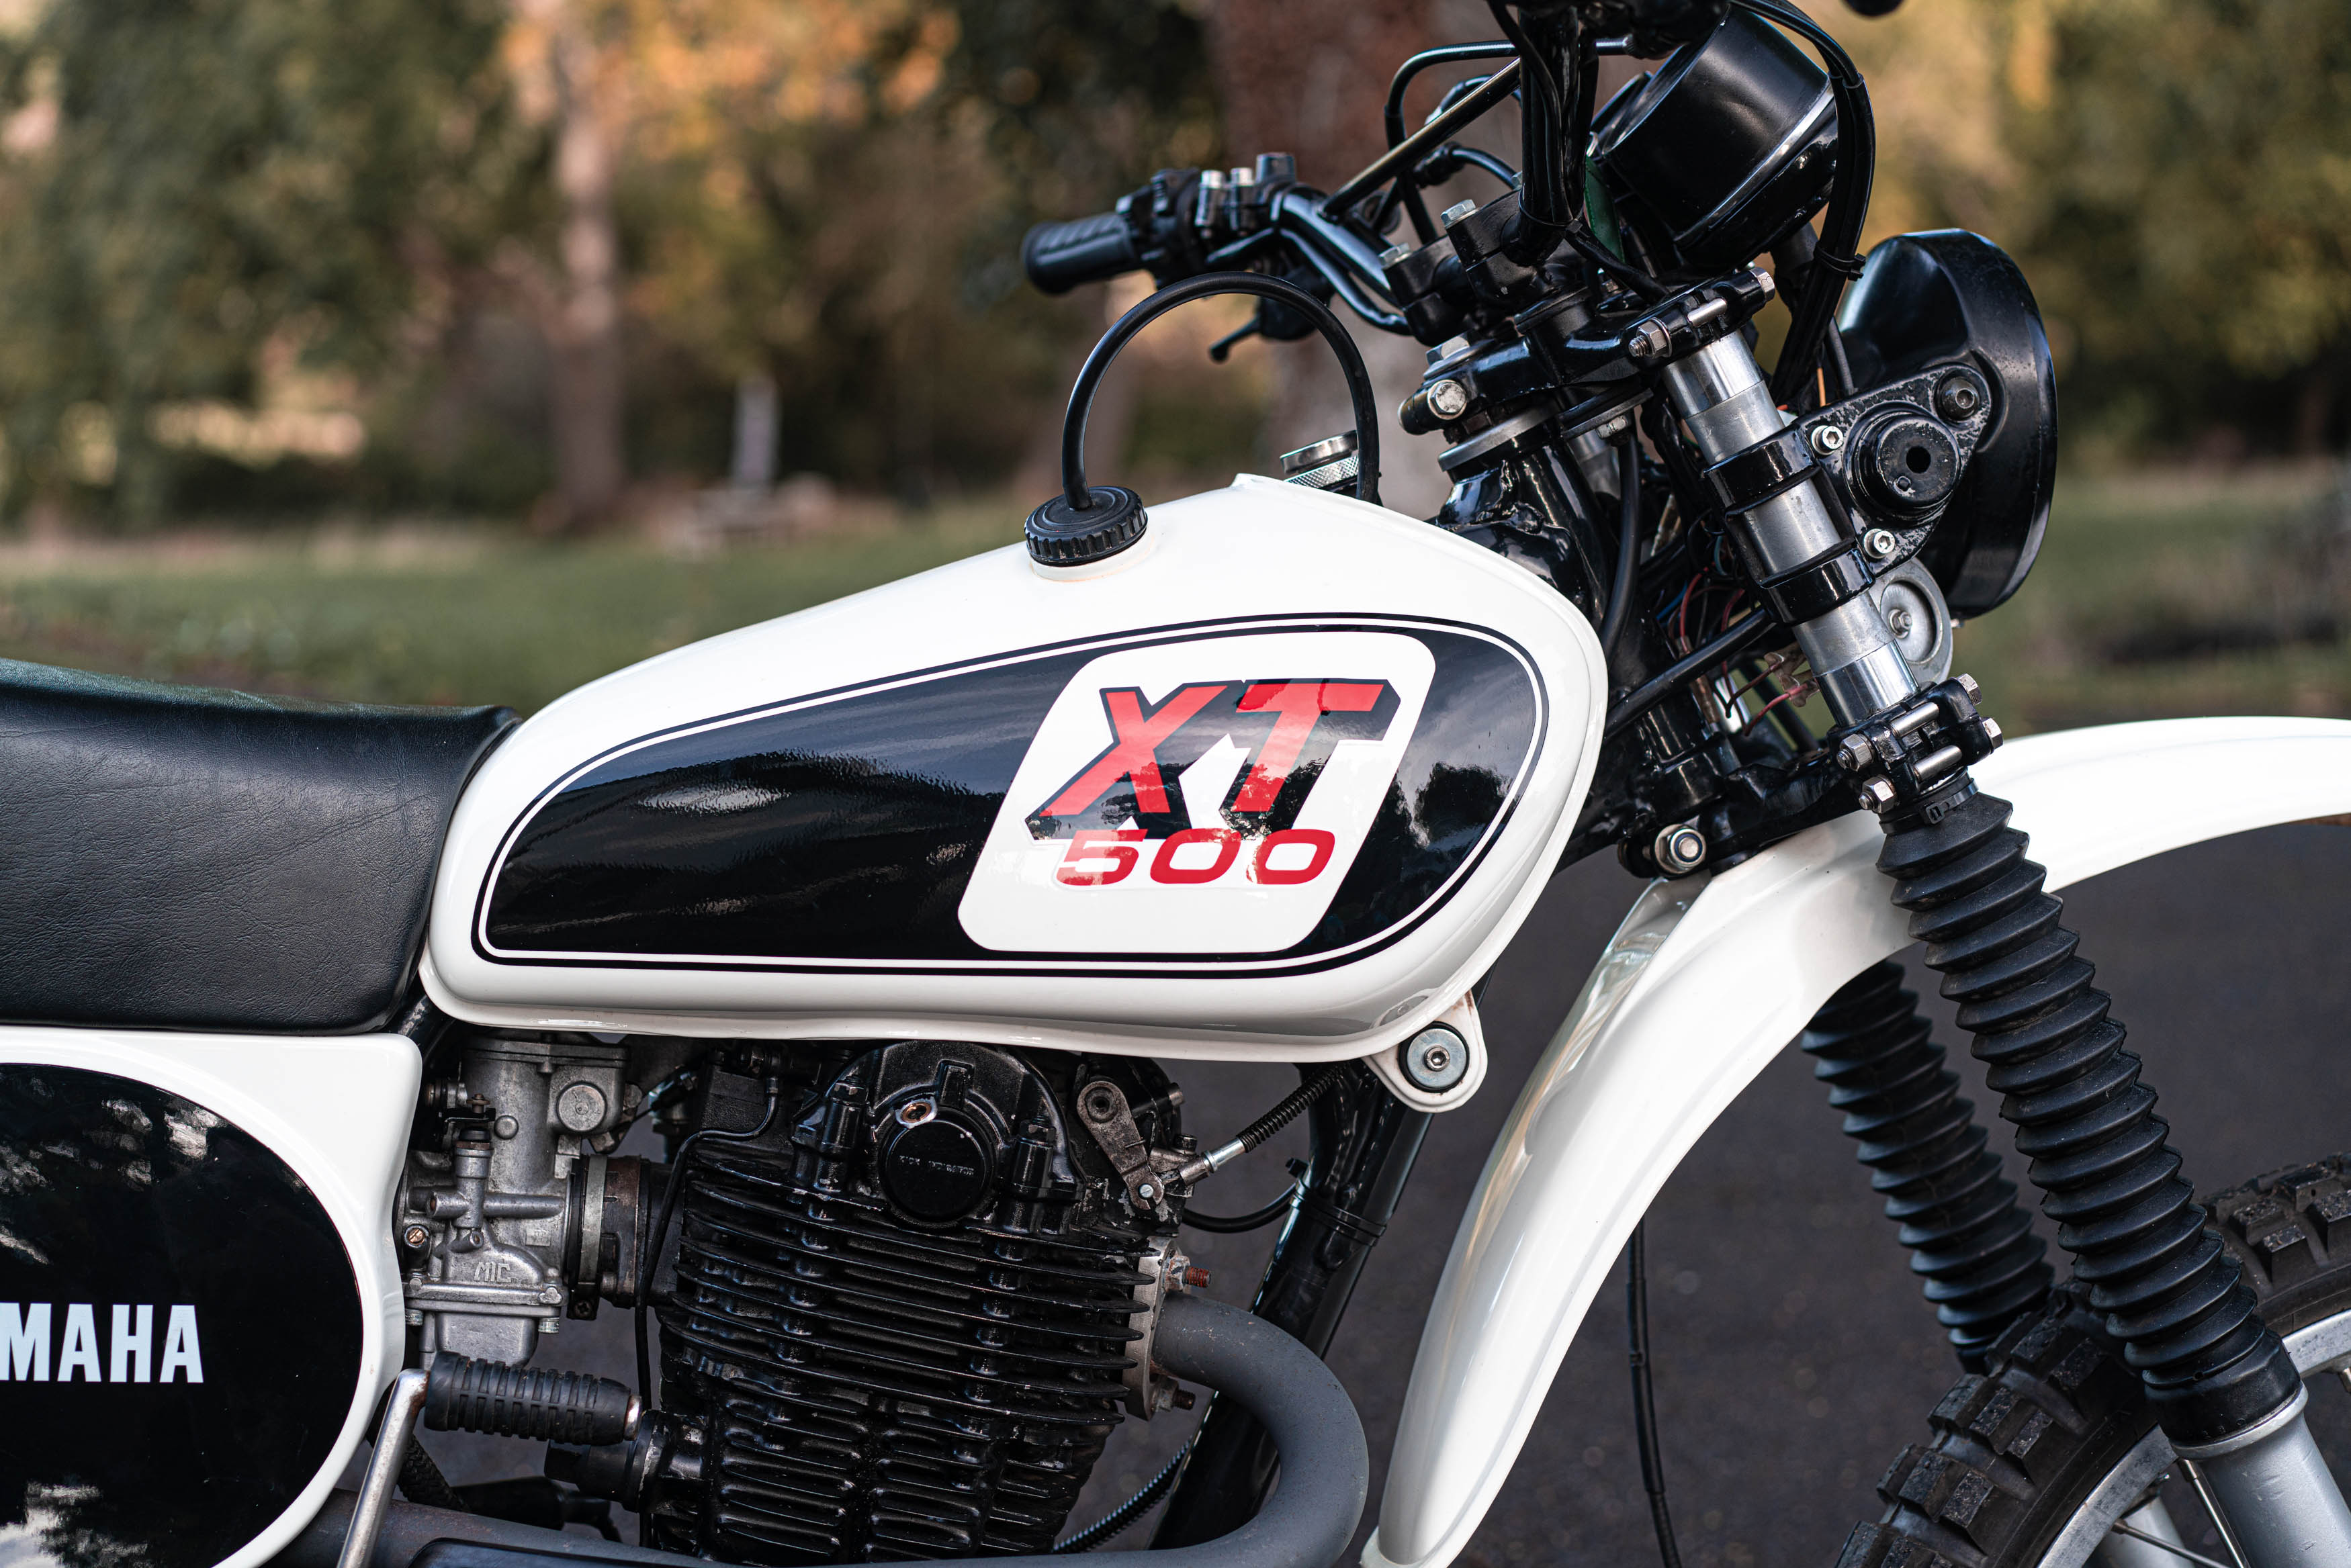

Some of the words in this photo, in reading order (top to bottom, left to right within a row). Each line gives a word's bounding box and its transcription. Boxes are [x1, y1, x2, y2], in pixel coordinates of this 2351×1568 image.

[1024, 678, 1402, 840] XT
[1055, 827, 1336, 886] 500
[474, 1262, 511, 1283] MIC
[0, 1301, 204, 1383] MAHA
